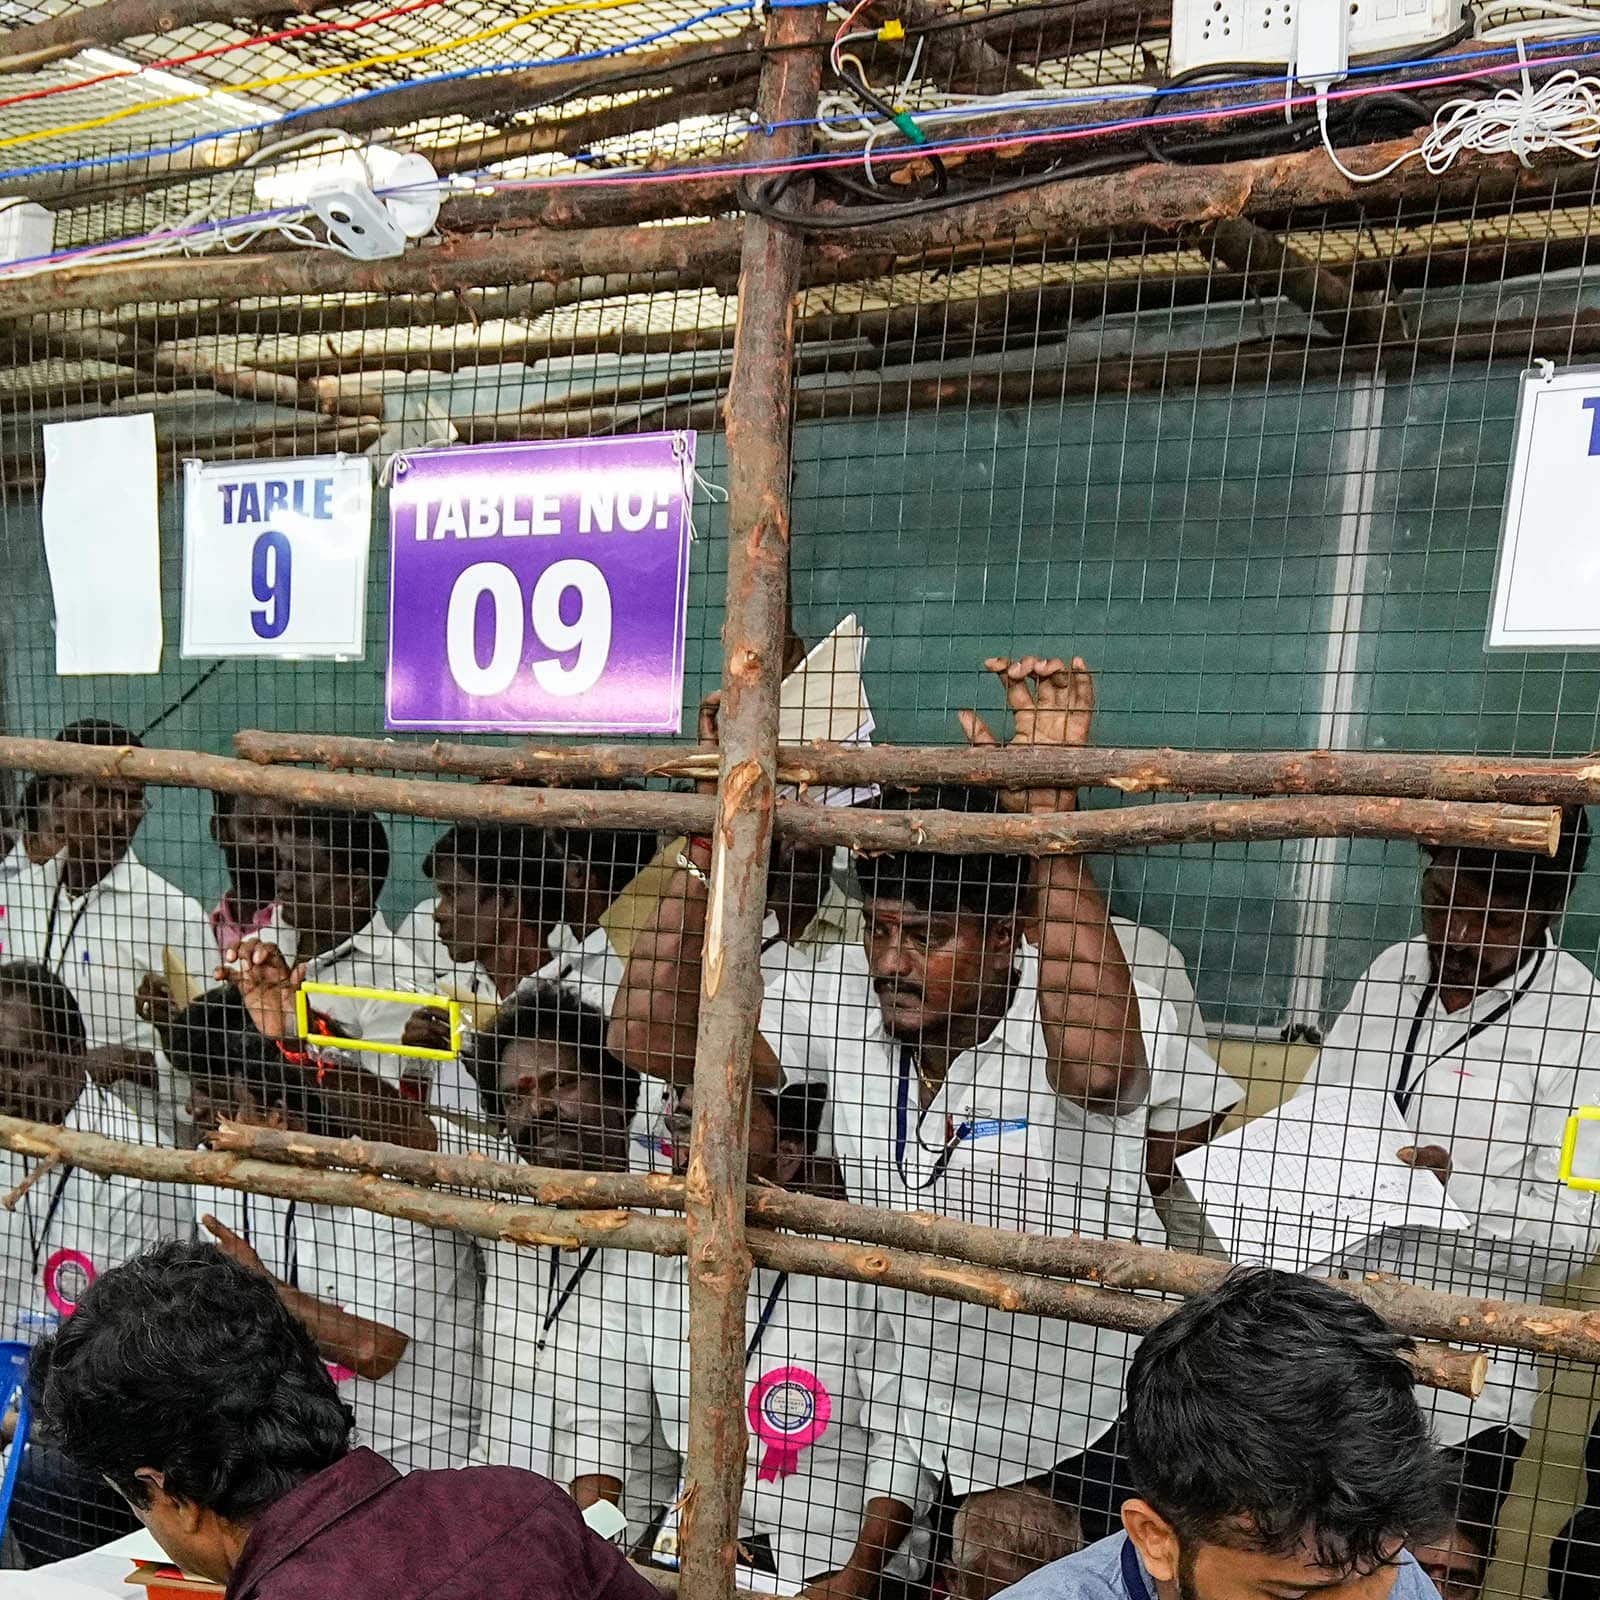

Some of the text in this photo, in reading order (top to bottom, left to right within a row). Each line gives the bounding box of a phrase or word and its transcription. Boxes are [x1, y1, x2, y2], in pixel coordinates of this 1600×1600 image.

[217, 477, 334, 524] TABLE
[408, 486, 670, 541] TABLE NO:
[249, 530, 293, 640] 9
[446, 558, 613, 698] 09
